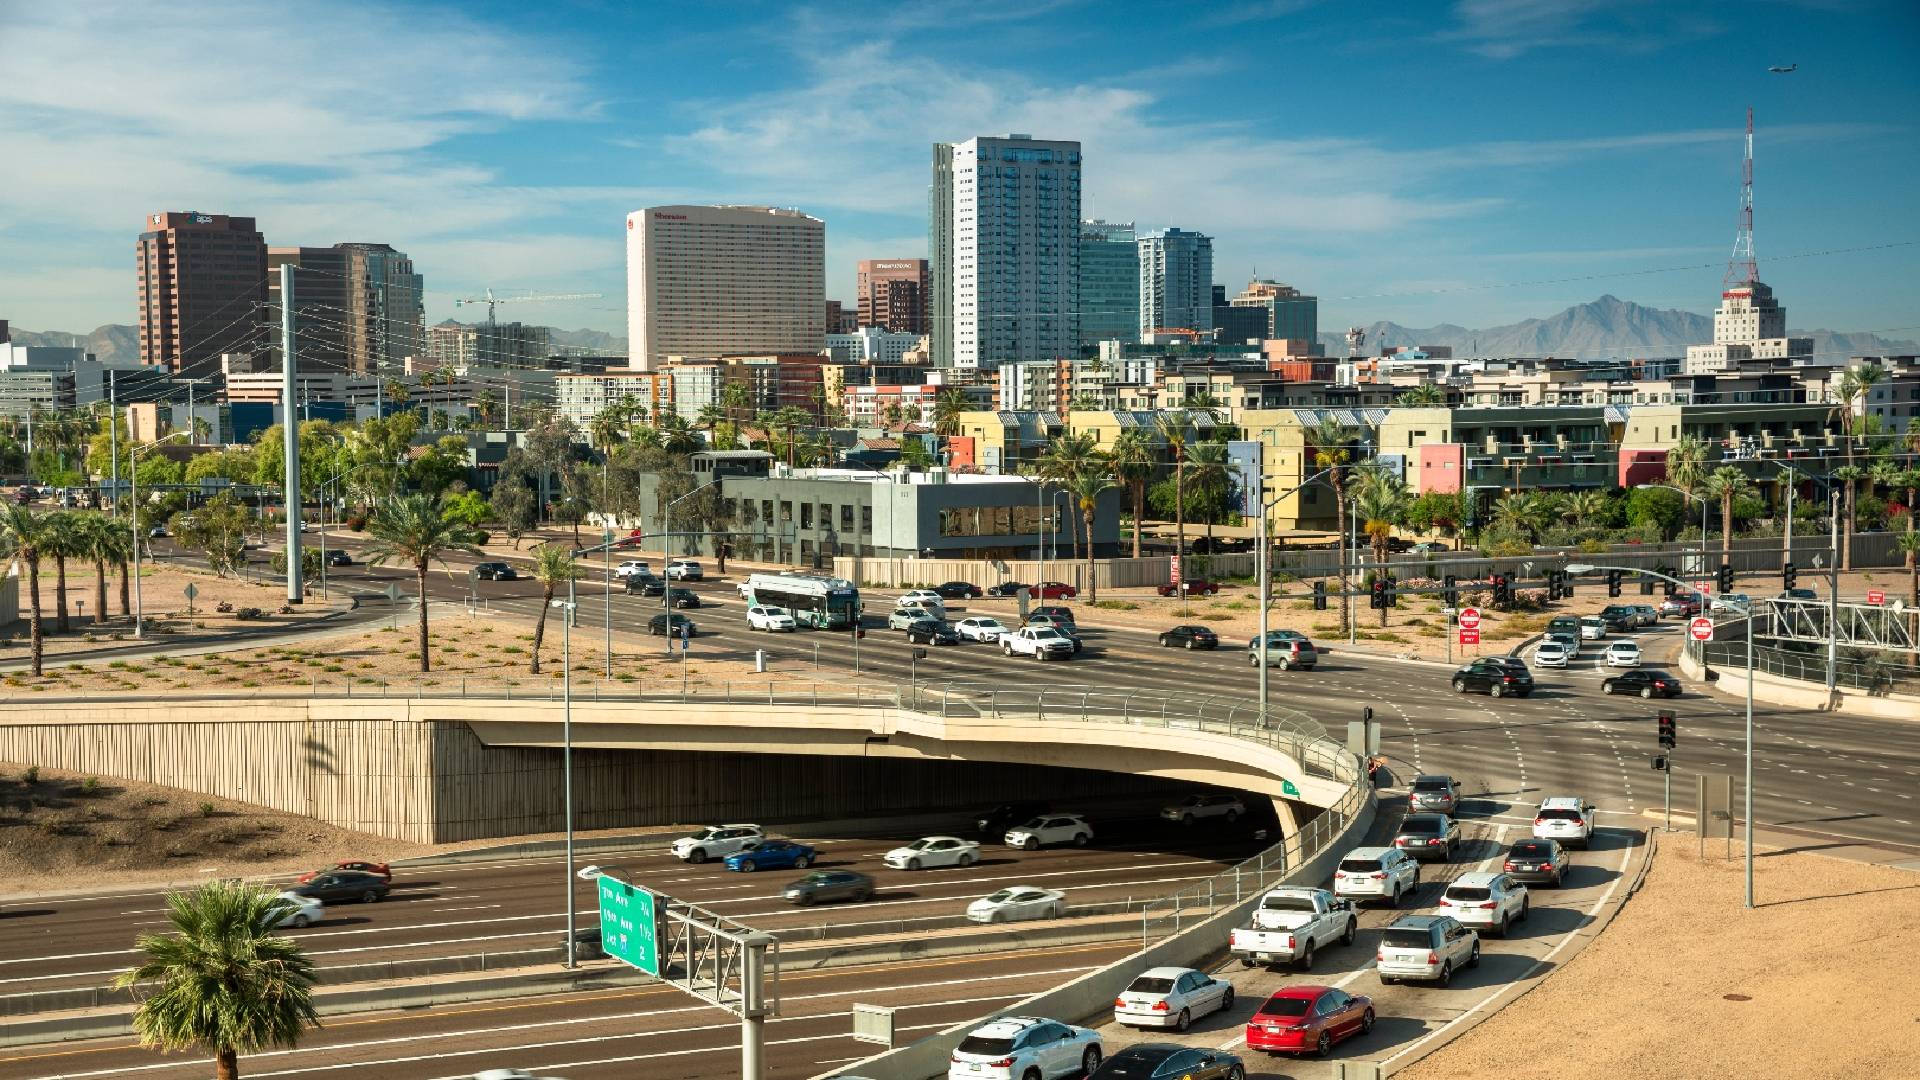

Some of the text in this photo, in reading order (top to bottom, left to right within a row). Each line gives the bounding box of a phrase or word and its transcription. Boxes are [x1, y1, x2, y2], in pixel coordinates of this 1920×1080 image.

[196, 215, 213, 224] aps
[616, 892, 628, 907] Ave
[640, 946, 645, 960] 2
